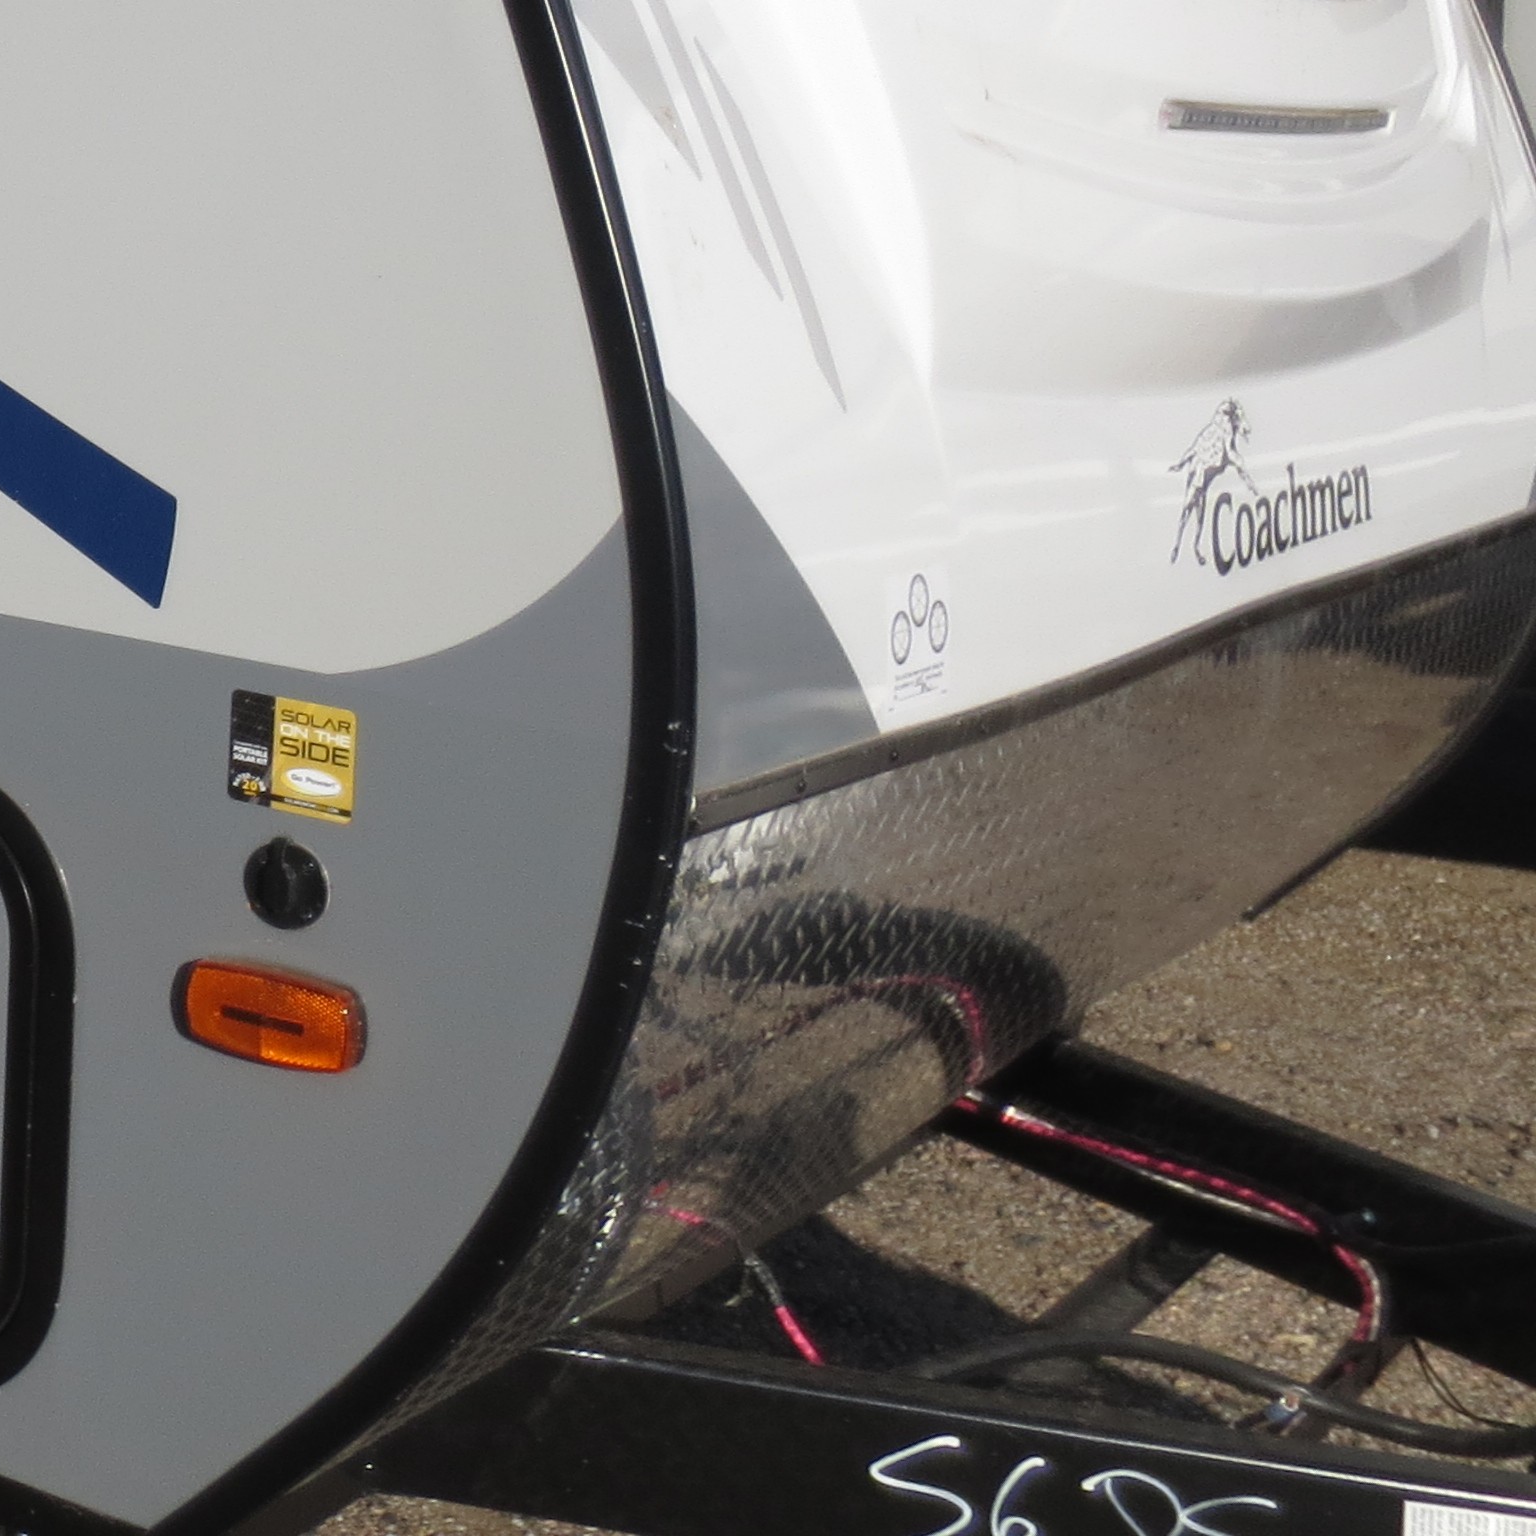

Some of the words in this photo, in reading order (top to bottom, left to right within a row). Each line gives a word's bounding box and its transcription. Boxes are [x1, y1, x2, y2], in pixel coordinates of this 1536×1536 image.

[1212, 462, 1372, 576] Coachmen
[280, 708, 352, 734] SOLAR
[280, 723, 309, 740] ON
[315, 729, 351, 749] THE
[279, 736, 350, 768] SIDE
